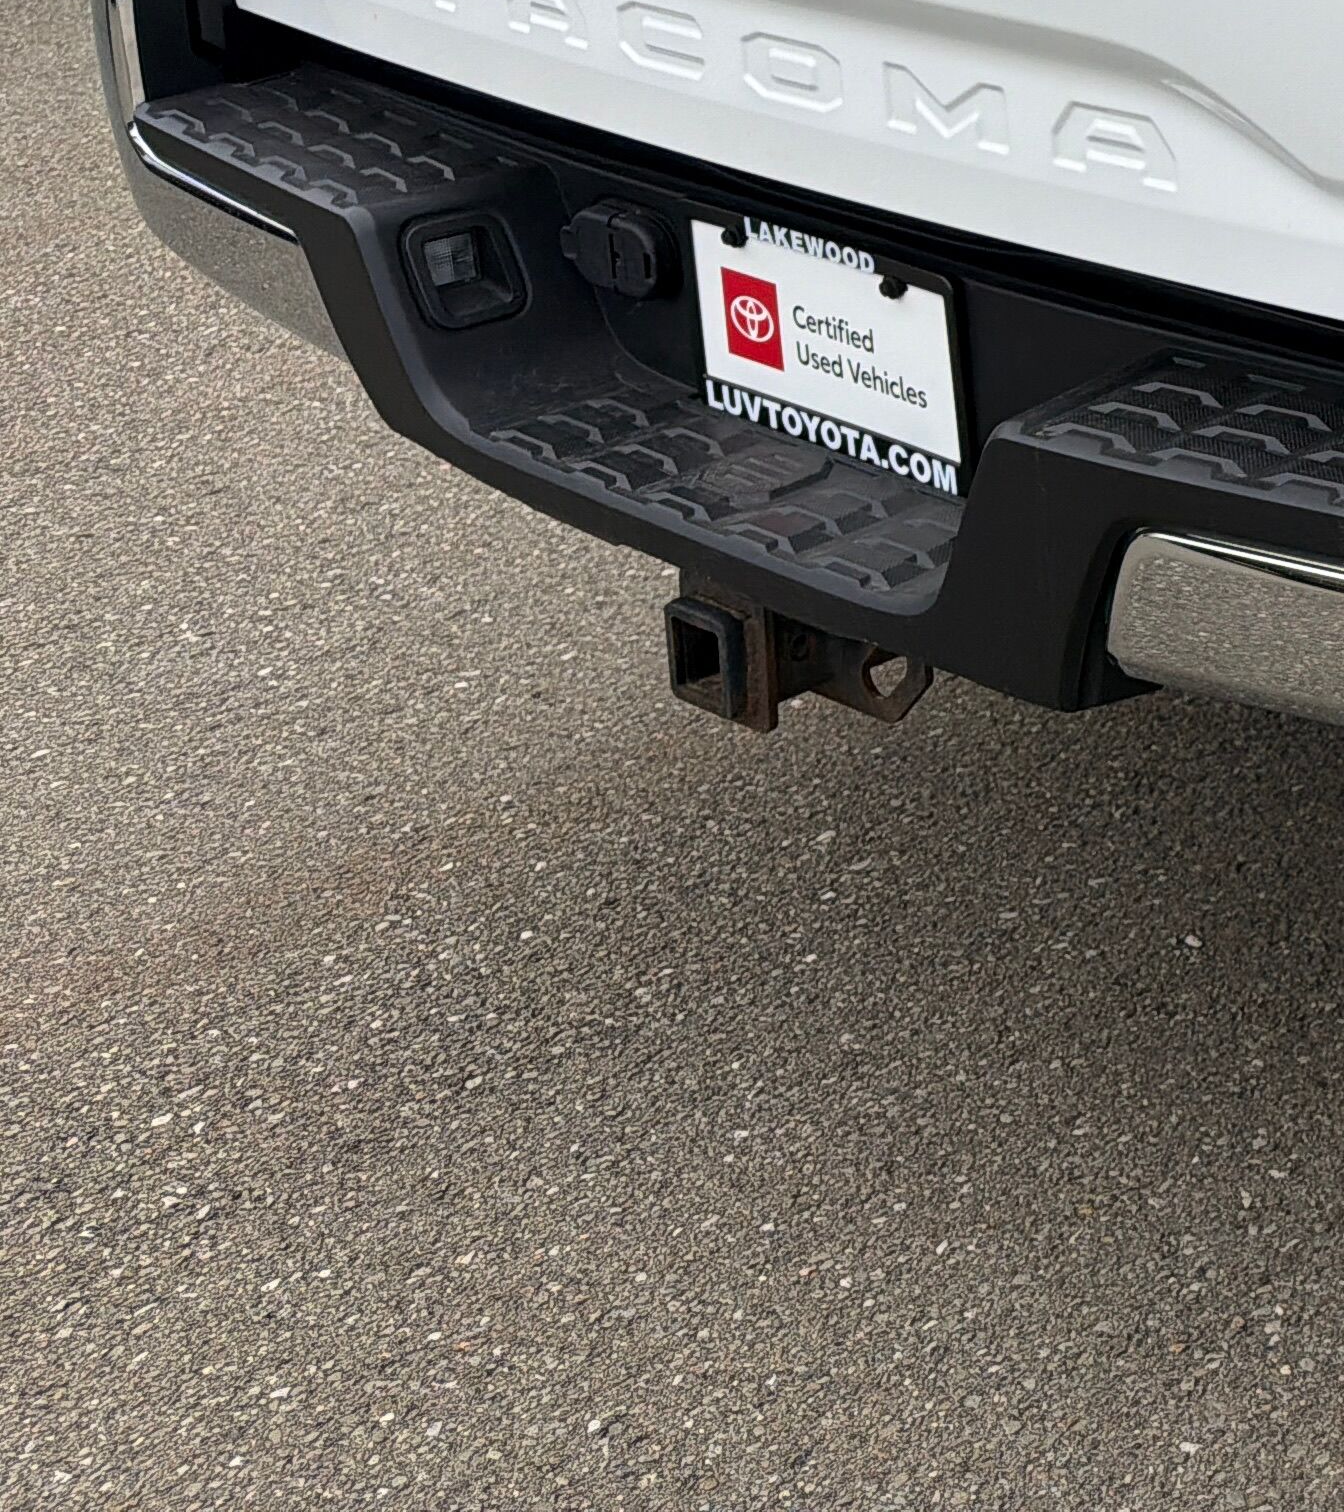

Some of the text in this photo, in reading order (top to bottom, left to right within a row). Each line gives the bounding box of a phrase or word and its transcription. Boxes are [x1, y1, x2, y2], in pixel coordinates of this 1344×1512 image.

[743, 216, 876, 275] LAKEWOOD
[793, 305, 875, 354] Certified
[796, 341, 928, 409] Used Vehicles
[706, 379, 959, 496] LUVTOYOTA.COM
